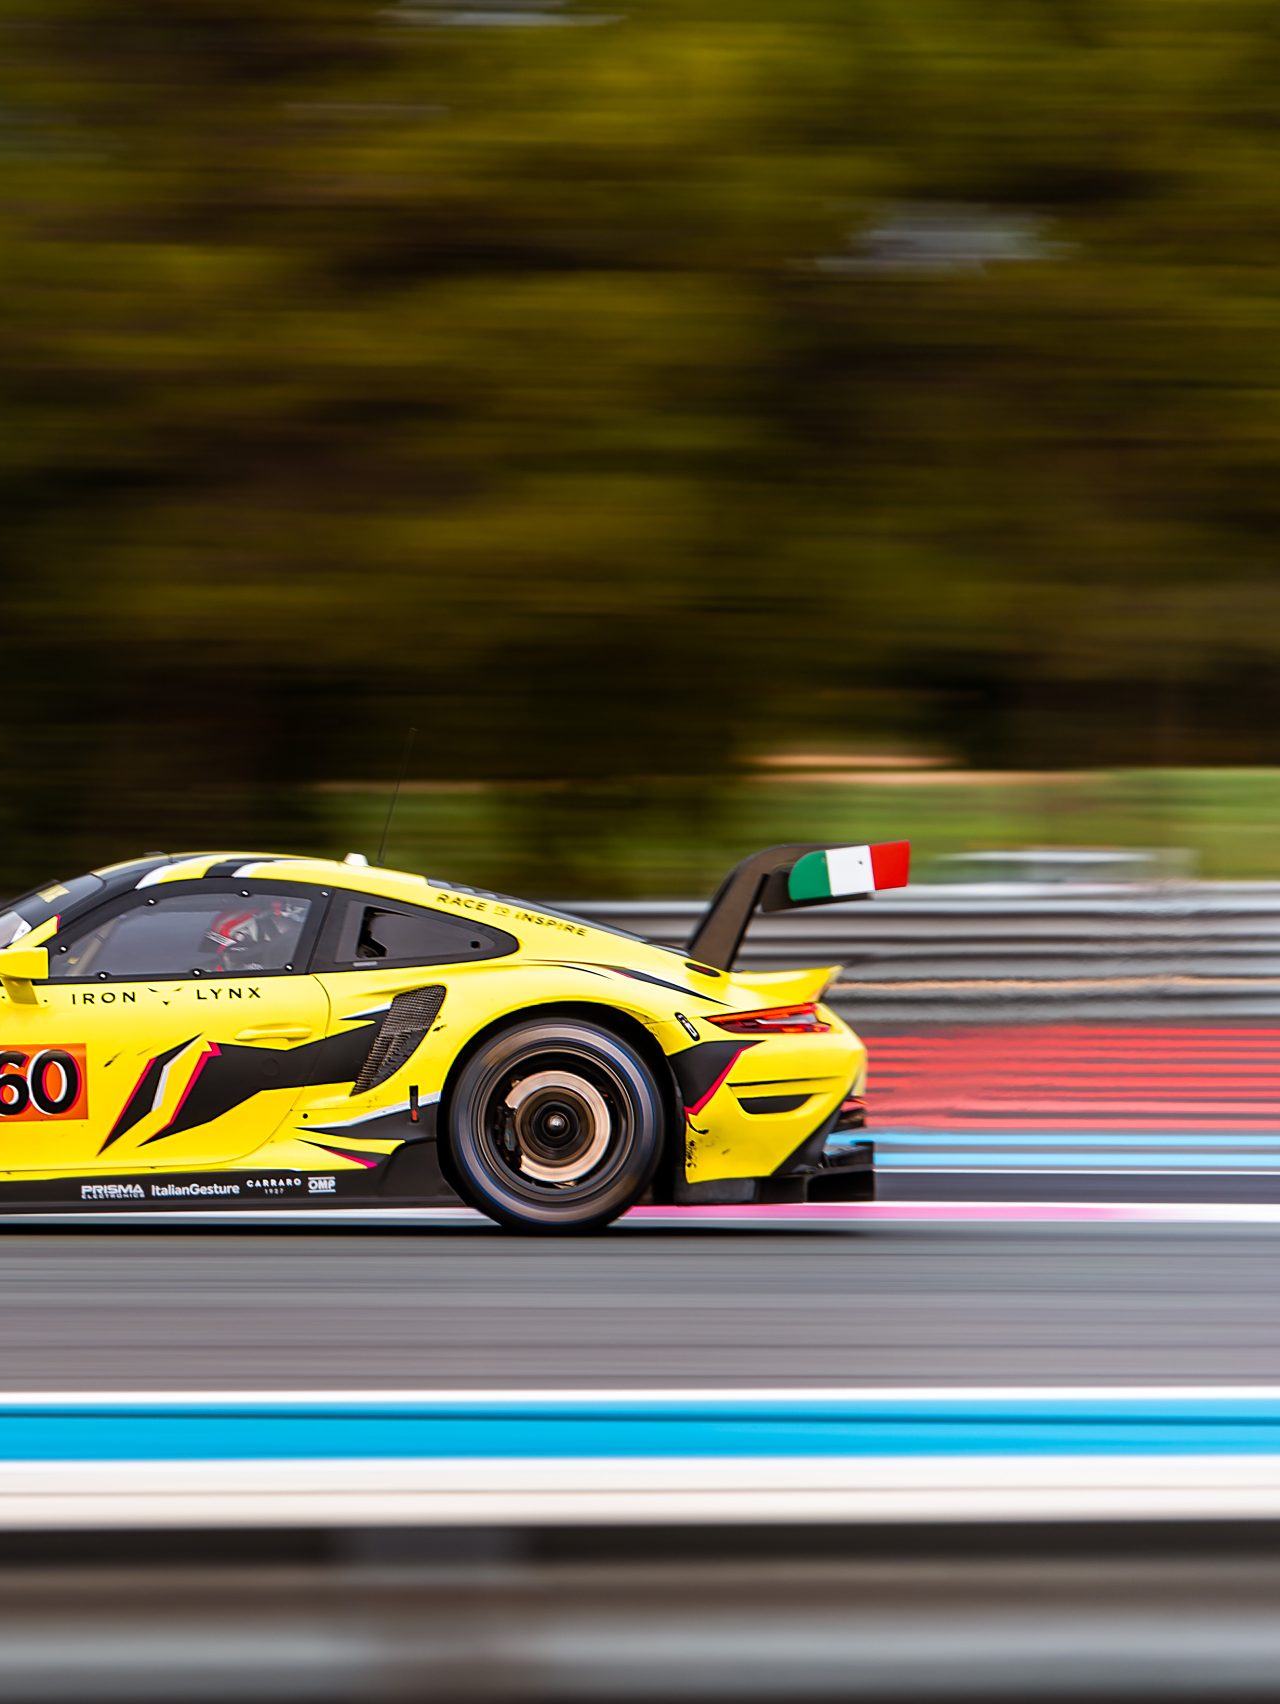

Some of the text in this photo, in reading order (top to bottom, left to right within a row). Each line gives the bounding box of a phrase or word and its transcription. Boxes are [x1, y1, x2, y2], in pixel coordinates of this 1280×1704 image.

[436, 893, 487, 912] RACE
[515, 911, 587, 937] INSPIRE
[72, 987, 261, 1005] IRON LYNX
[81, 1184, 143, 1195] PRISMA
[151, 1183, 240, 1196] ItalianGesture
[246, 1178, 302, 1188] CARRARO
[307, 1177, 336, 1193] OMP
